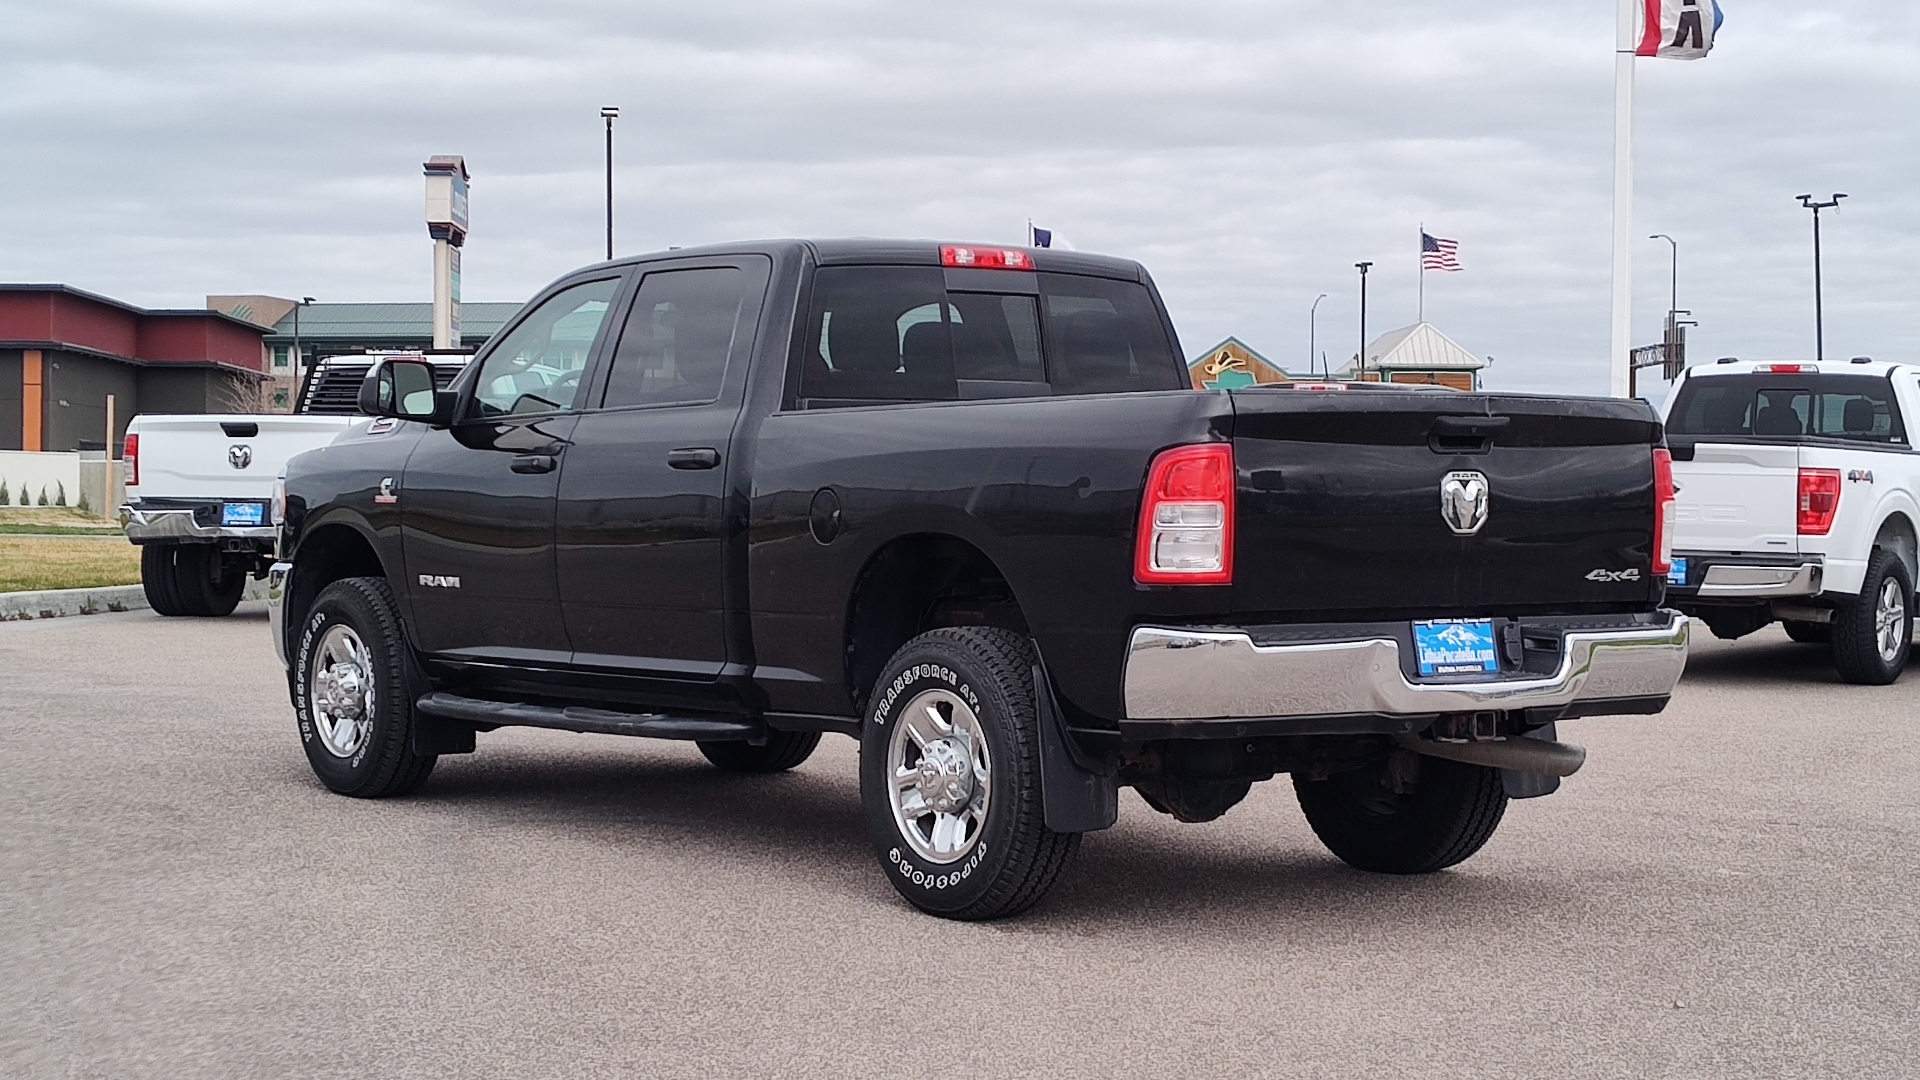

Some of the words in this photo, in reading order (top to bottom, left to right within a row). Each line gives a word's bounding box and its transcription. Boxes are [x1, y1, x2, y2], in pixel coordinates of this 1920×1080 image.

[419, 574, 461, 588] RAM
[1419, 646, 1494, 664] LithiaPocatello.com
[873, 664, 958, 725] TRANSFORCE
